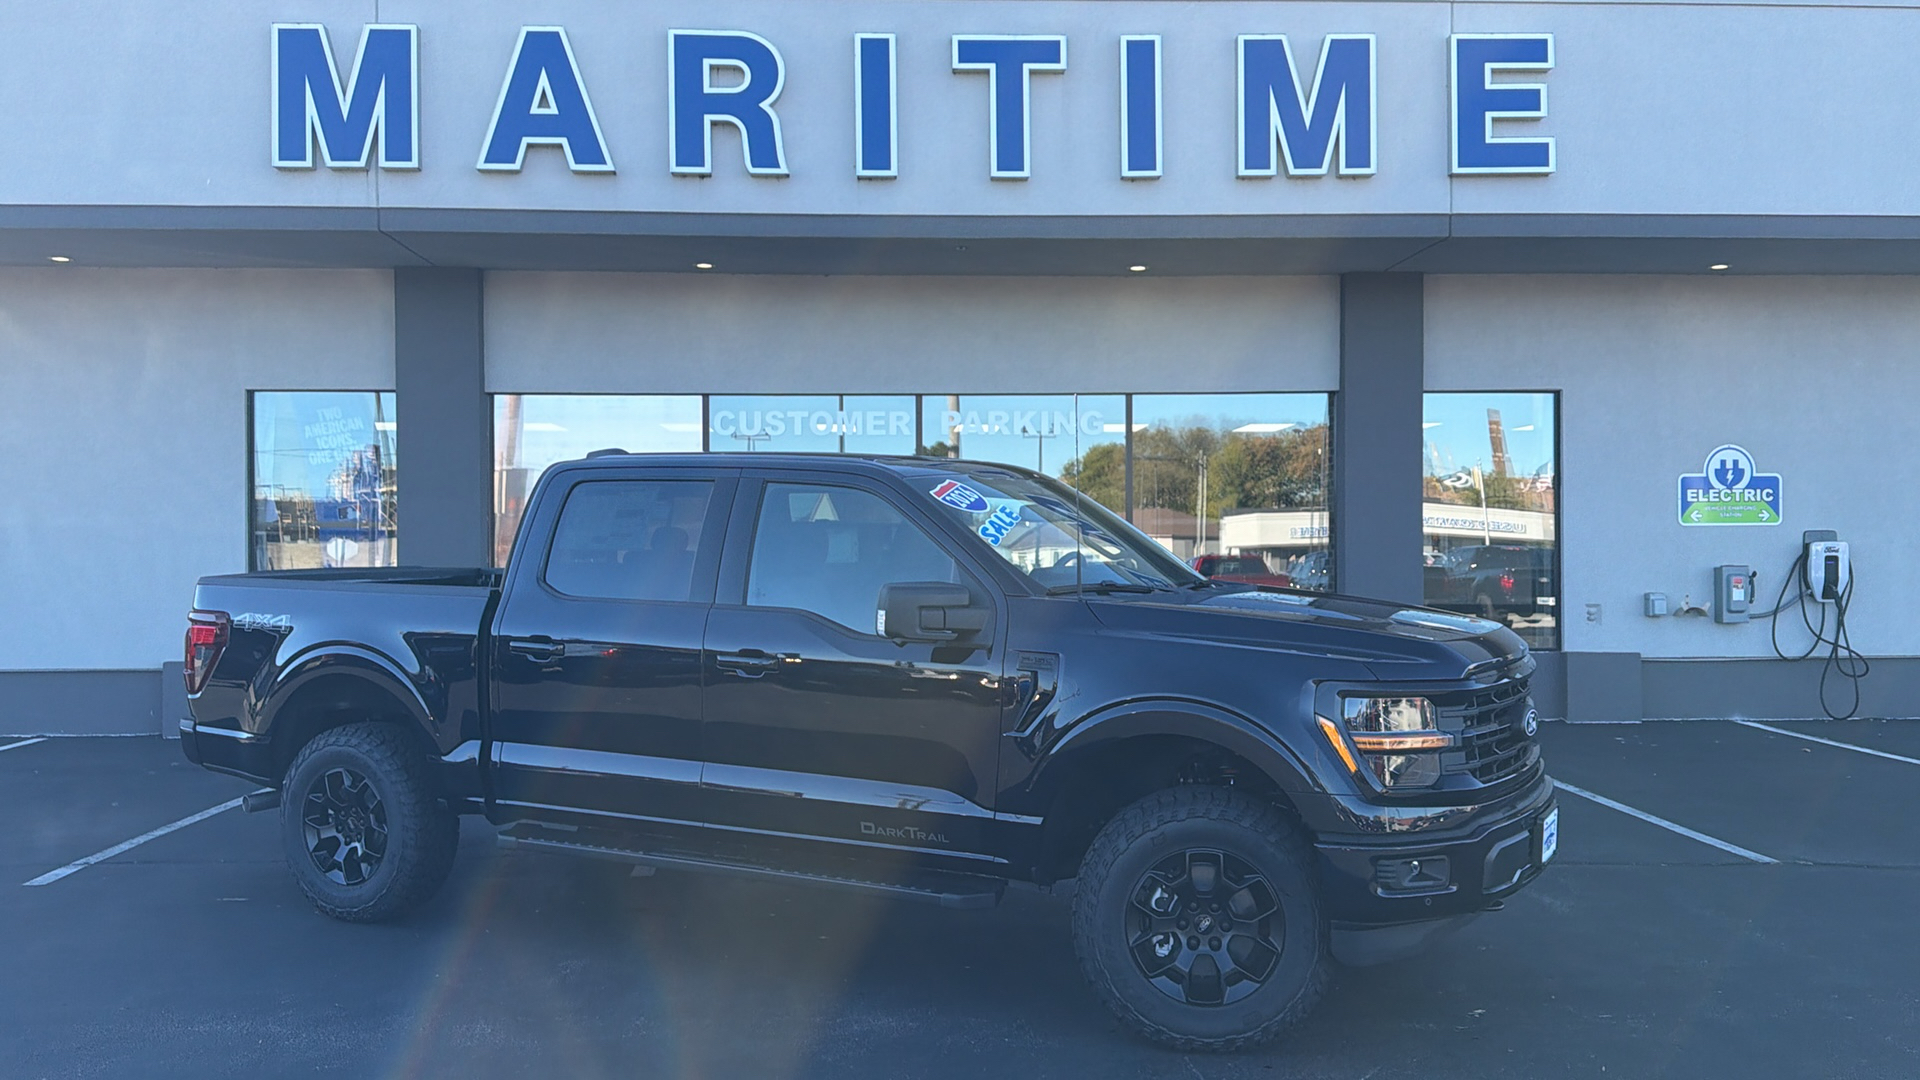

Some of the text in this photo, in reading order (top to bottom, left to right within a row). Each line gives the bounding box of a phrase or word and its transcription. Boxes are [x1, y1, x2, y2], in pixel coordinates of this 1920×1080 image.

[271, 22, 1556, 180] MARITIME
[316, 406, 342, 420] TWO
[713, 410, 1105, 436] CUSTOMER PARKING
[304, 416, 364, 439] AMERICAN
[308, 449, 334, 465] ONE
[945, 486, 979, 508] 2026
[1686, 488, 1774, 502] ELECTRIC
[978, 504, 1021, 546] SALE
